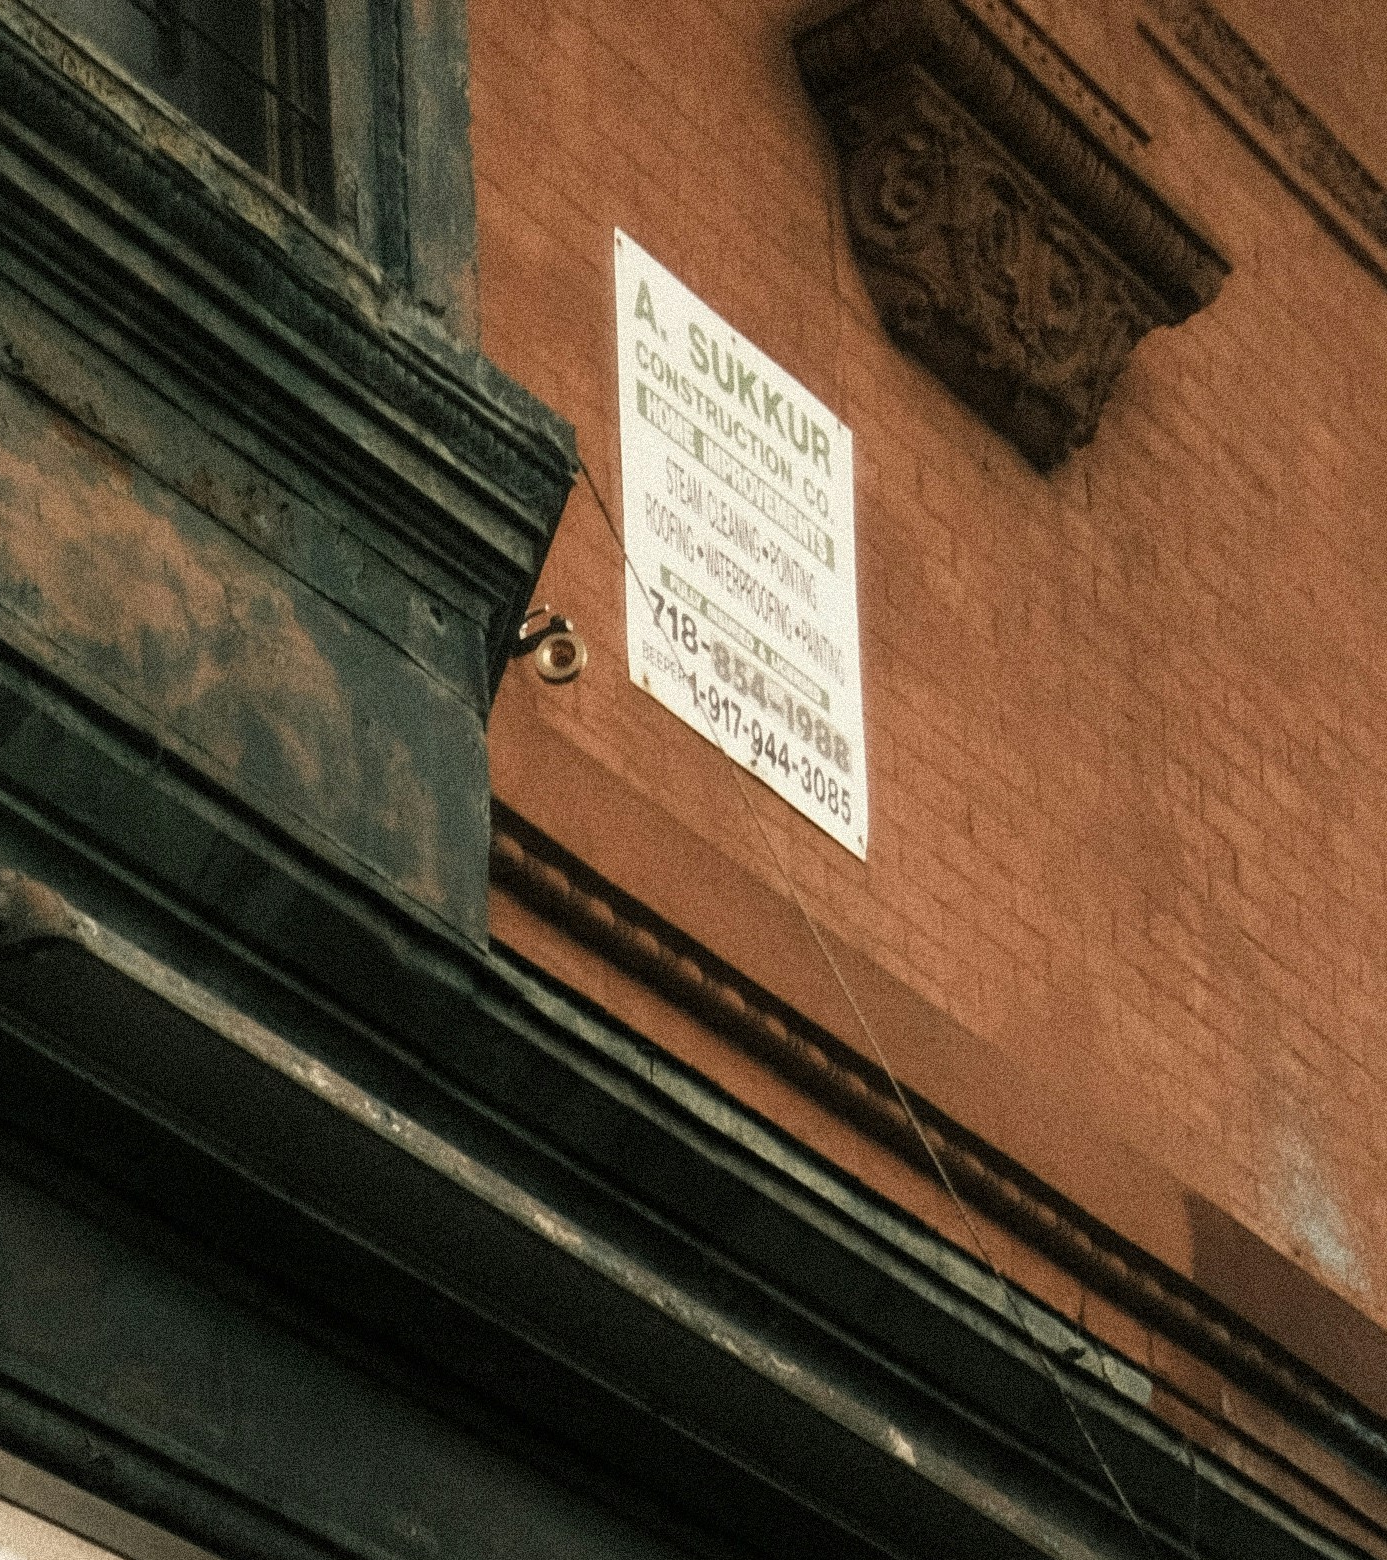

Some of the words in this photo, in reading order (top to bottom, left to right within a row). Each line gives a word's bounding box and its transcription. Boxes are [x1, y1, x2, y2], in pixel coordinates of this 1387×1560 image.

[635, 280, 667, 342] A.
[688, 322, 832, 479] SUKKUR
[635, 340, 793, 487] CONSTRUCTION
[803, 477, 834, 525] CO.
[646, 390, 695, 450] HOME
[703, 437, 826, 560] IMPROVEMENTS
[665, 456, 703, 519] STEAM
[688, 670, 852, 826] 1-917-944-3085
